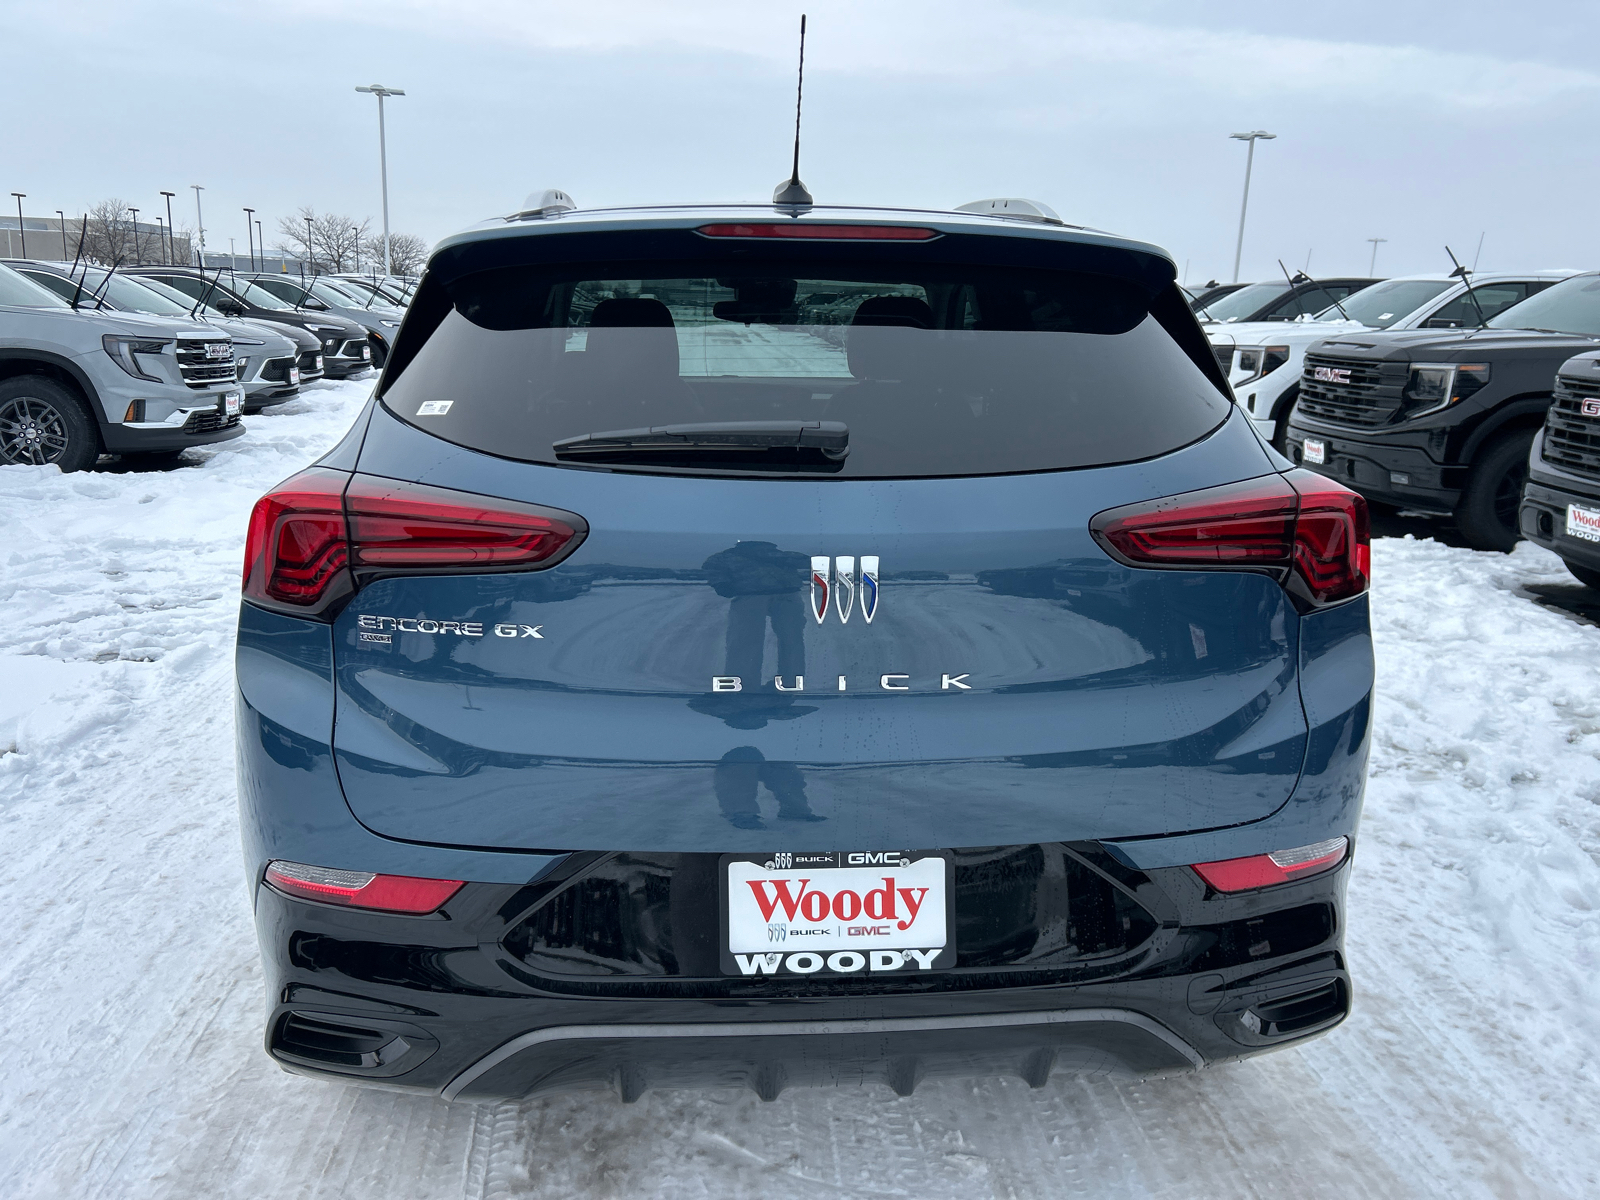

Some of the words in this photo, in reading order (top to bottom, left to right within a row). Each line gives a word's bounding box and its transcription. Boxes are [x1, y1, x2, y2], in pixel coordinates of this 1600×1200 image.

[1315, 366, 1351, 384] GMC
[358, 614, 483, 636] ENCORE
[494, 623, 544, 639] GX
[712, 673, 972, 692] BUICK
[847, 852, 901, 865] GMC
[745, 877, 930, 931] Woody
[847, 925, 891, 936] GMC
[734, 949, 943, 976] WOODY
